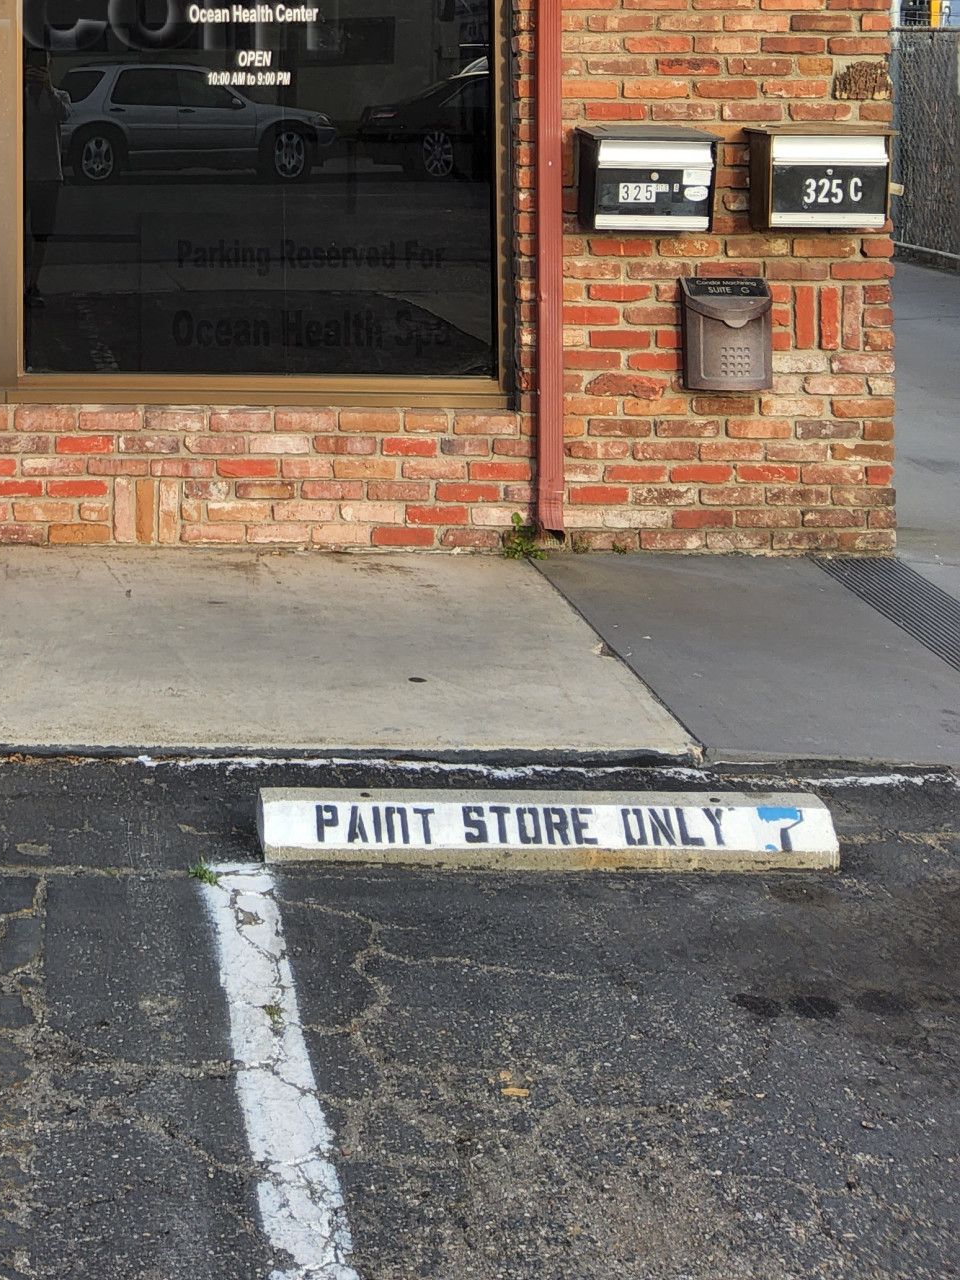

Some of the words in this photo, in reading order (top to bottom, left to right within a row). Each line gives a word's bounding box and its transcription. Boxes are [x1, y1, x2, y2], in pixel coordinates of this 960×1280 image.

[189, 4, 230, 23] Ocean
[232, 4, 274, 22] Health
[275, 3, 319, 22] Center
[238, 50, 272, 67] OPEN
[207, 71, 231, 86] 10:00
[231, 72, 246, 85] AM
[246, 72, 256, 85] to
[256, 71, 276, 85] 9:00
[276, 71, 291, 85] PM
[621, 184, 653, 201] 325
[803, 178, 843, 204] 325
[849, 177, 863, 202] C
[176, 239, 270, 276] Parking
[279, 239, 397, 269] Reserved
[404, 239, 447, 269] For
[707, 286, 733, 294] SUITE
[171, 309, 271, 348] Ocean
[280, 309, 384, 348] Health
[315, 805, 436, 845] PAINT
[461, 805, 599, 846] STORE
[623, 806, 733, 848] ONLY
